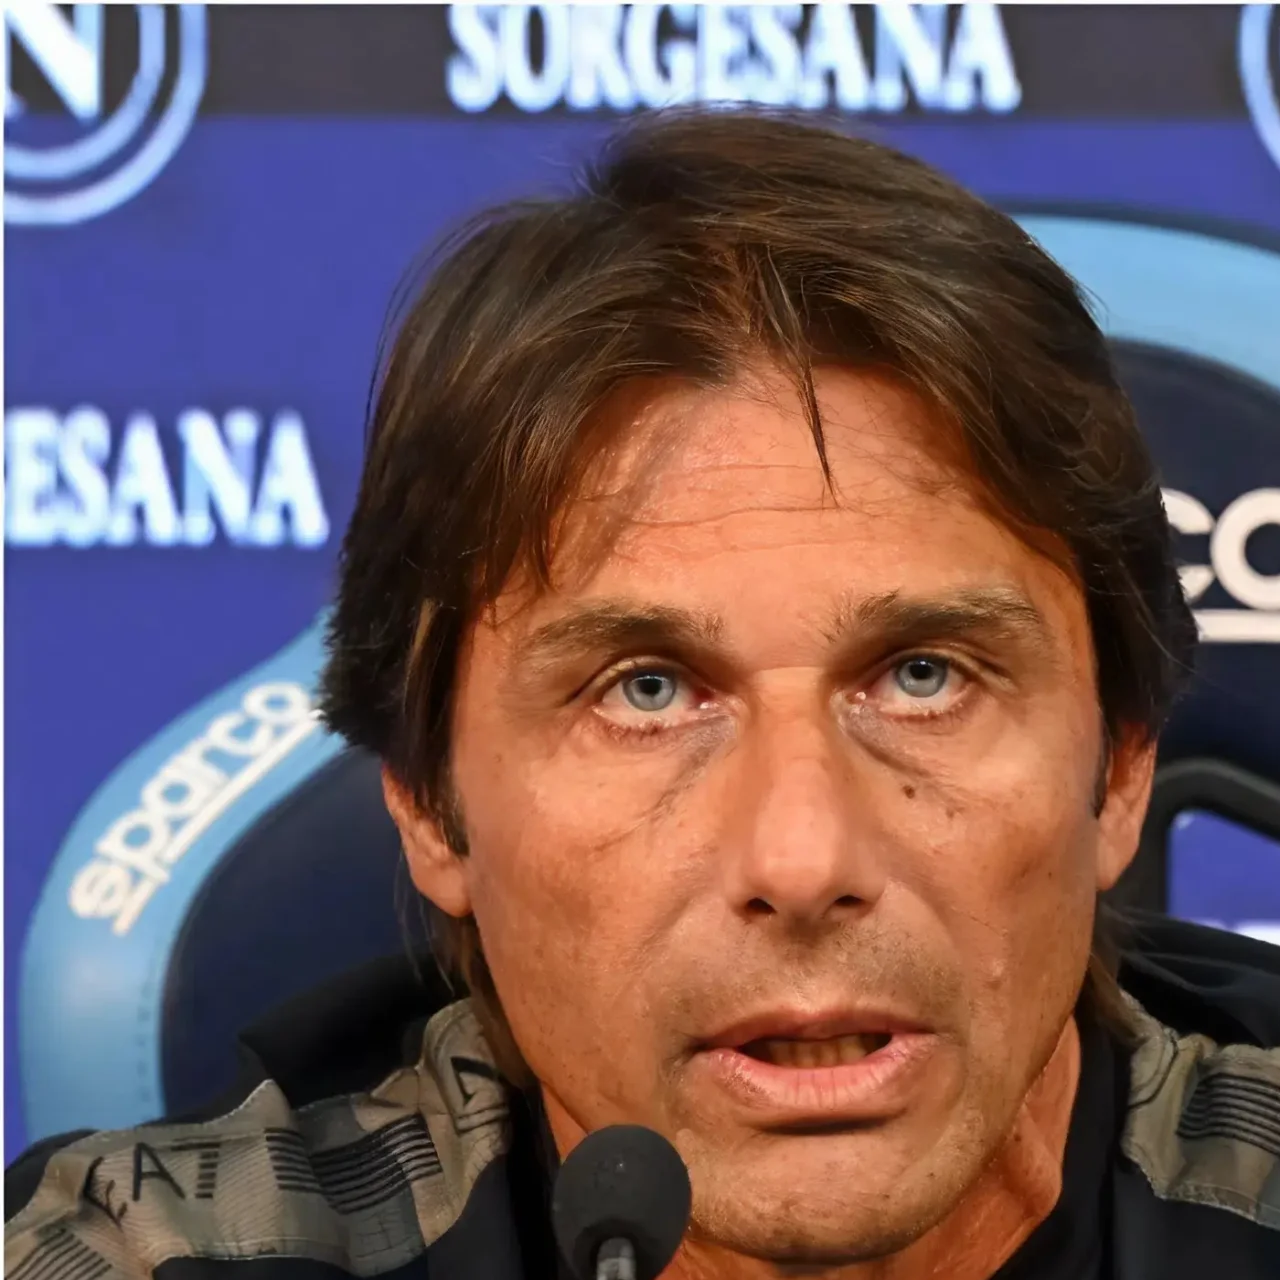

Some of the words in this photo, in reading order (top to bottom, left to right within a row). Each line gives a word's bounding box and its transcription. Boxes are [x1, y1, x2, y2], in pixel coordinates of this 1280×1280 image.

[446, 3, 1021, 112] SORGESANA
[3, 407, 329, 548] ESANA
[68, 681, 312, 918] sparco
